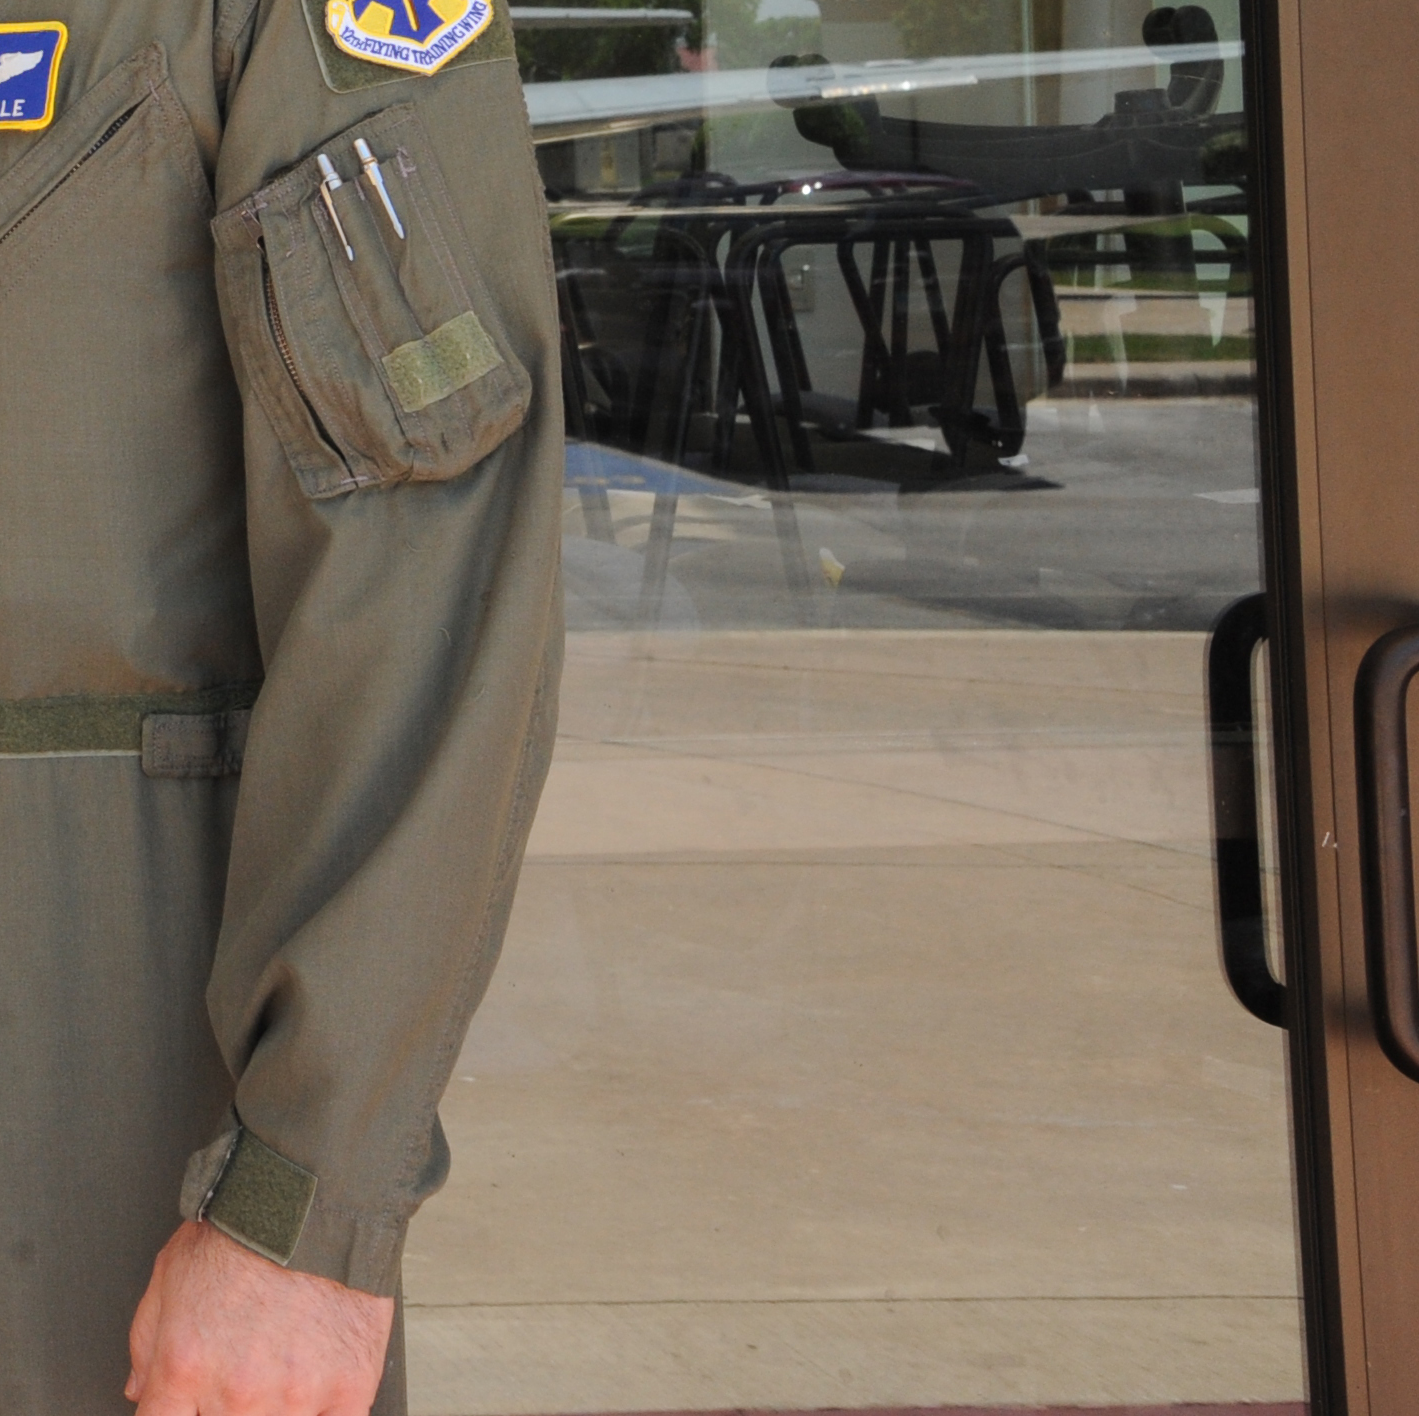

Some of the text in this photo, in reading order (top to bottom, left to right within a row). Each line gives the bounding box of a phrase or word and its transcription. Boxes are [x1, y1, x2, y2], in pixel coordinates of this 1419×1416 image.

[363, 37, 410, 61] FLYING
[412, 26, 464, 65] TRAINING
[459, 1, 487, 35] WING
